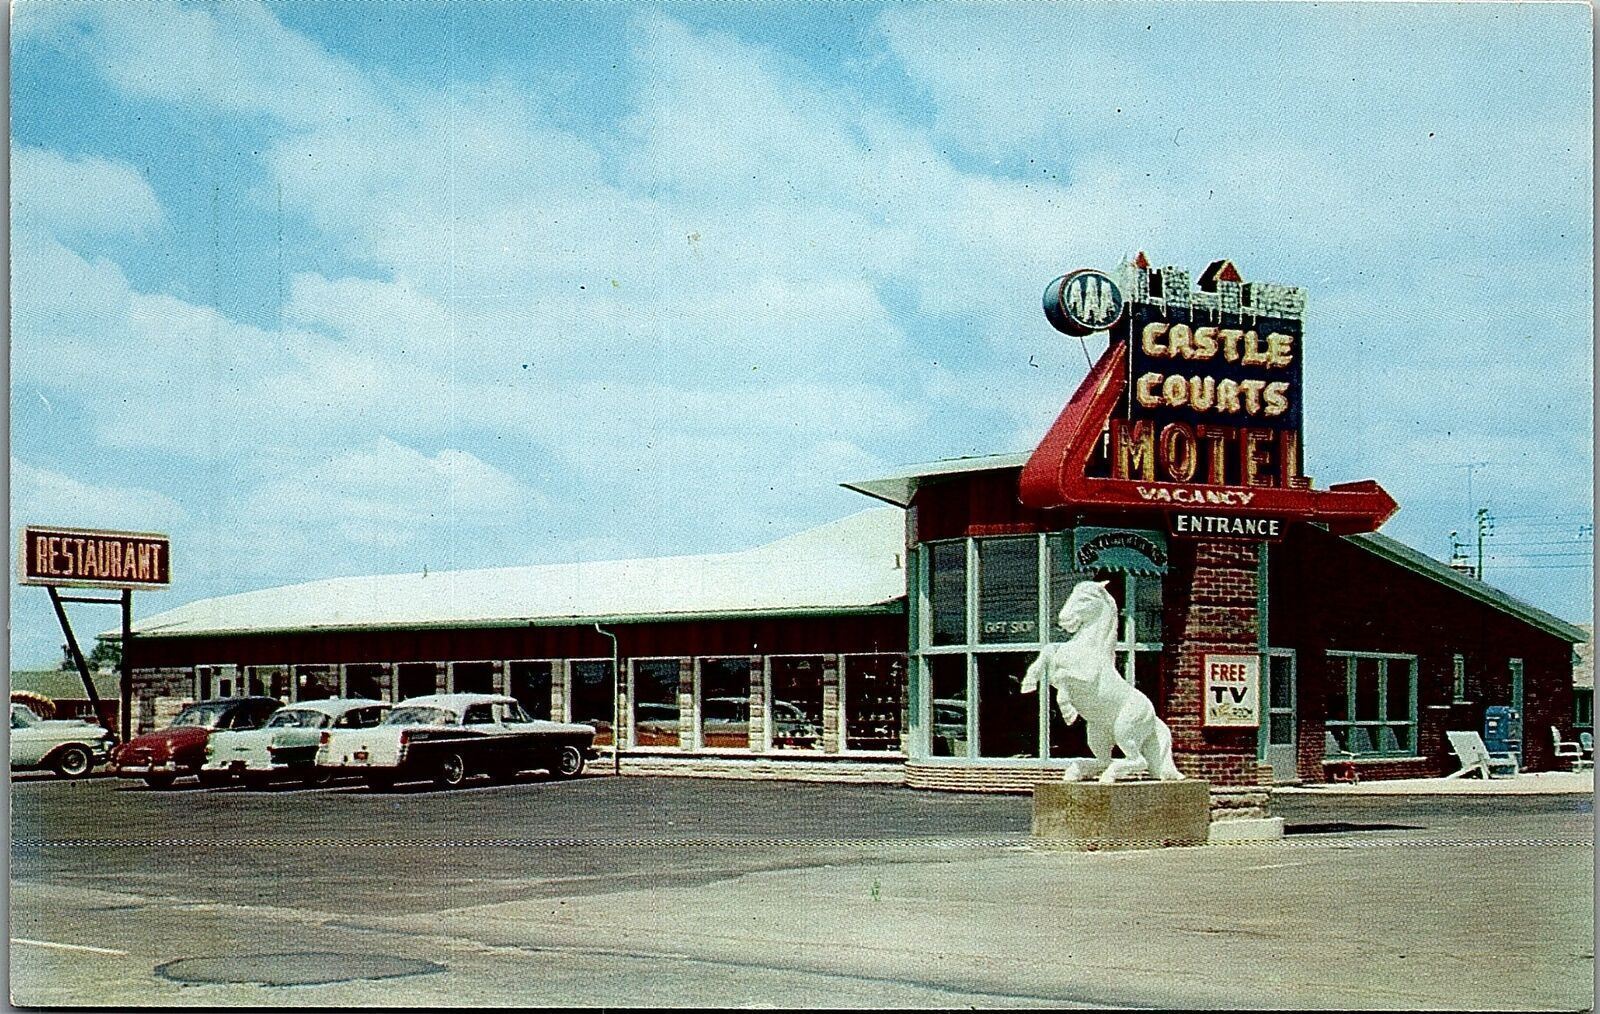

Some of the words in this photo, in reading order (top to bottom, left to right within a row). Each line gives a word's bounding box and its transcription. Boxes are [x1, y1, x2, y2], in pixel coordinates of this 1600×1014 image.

[1068, 275, 1116, 323] AAA
[1141, 322, 1294, 370] CASTLE
[1136, 371, 1291, 417] COURTS
[1111, 419, 1312, 490] MOTEL
[1136, 485, 1256, 506] VACANCY
[1176, 514, 1280, 537] ENTRANCE
[35, 535, 162, 581] RESTAURANT
[1210, 663, 1247, 682] FREE
[1210, 686, 1248, 704] TV
